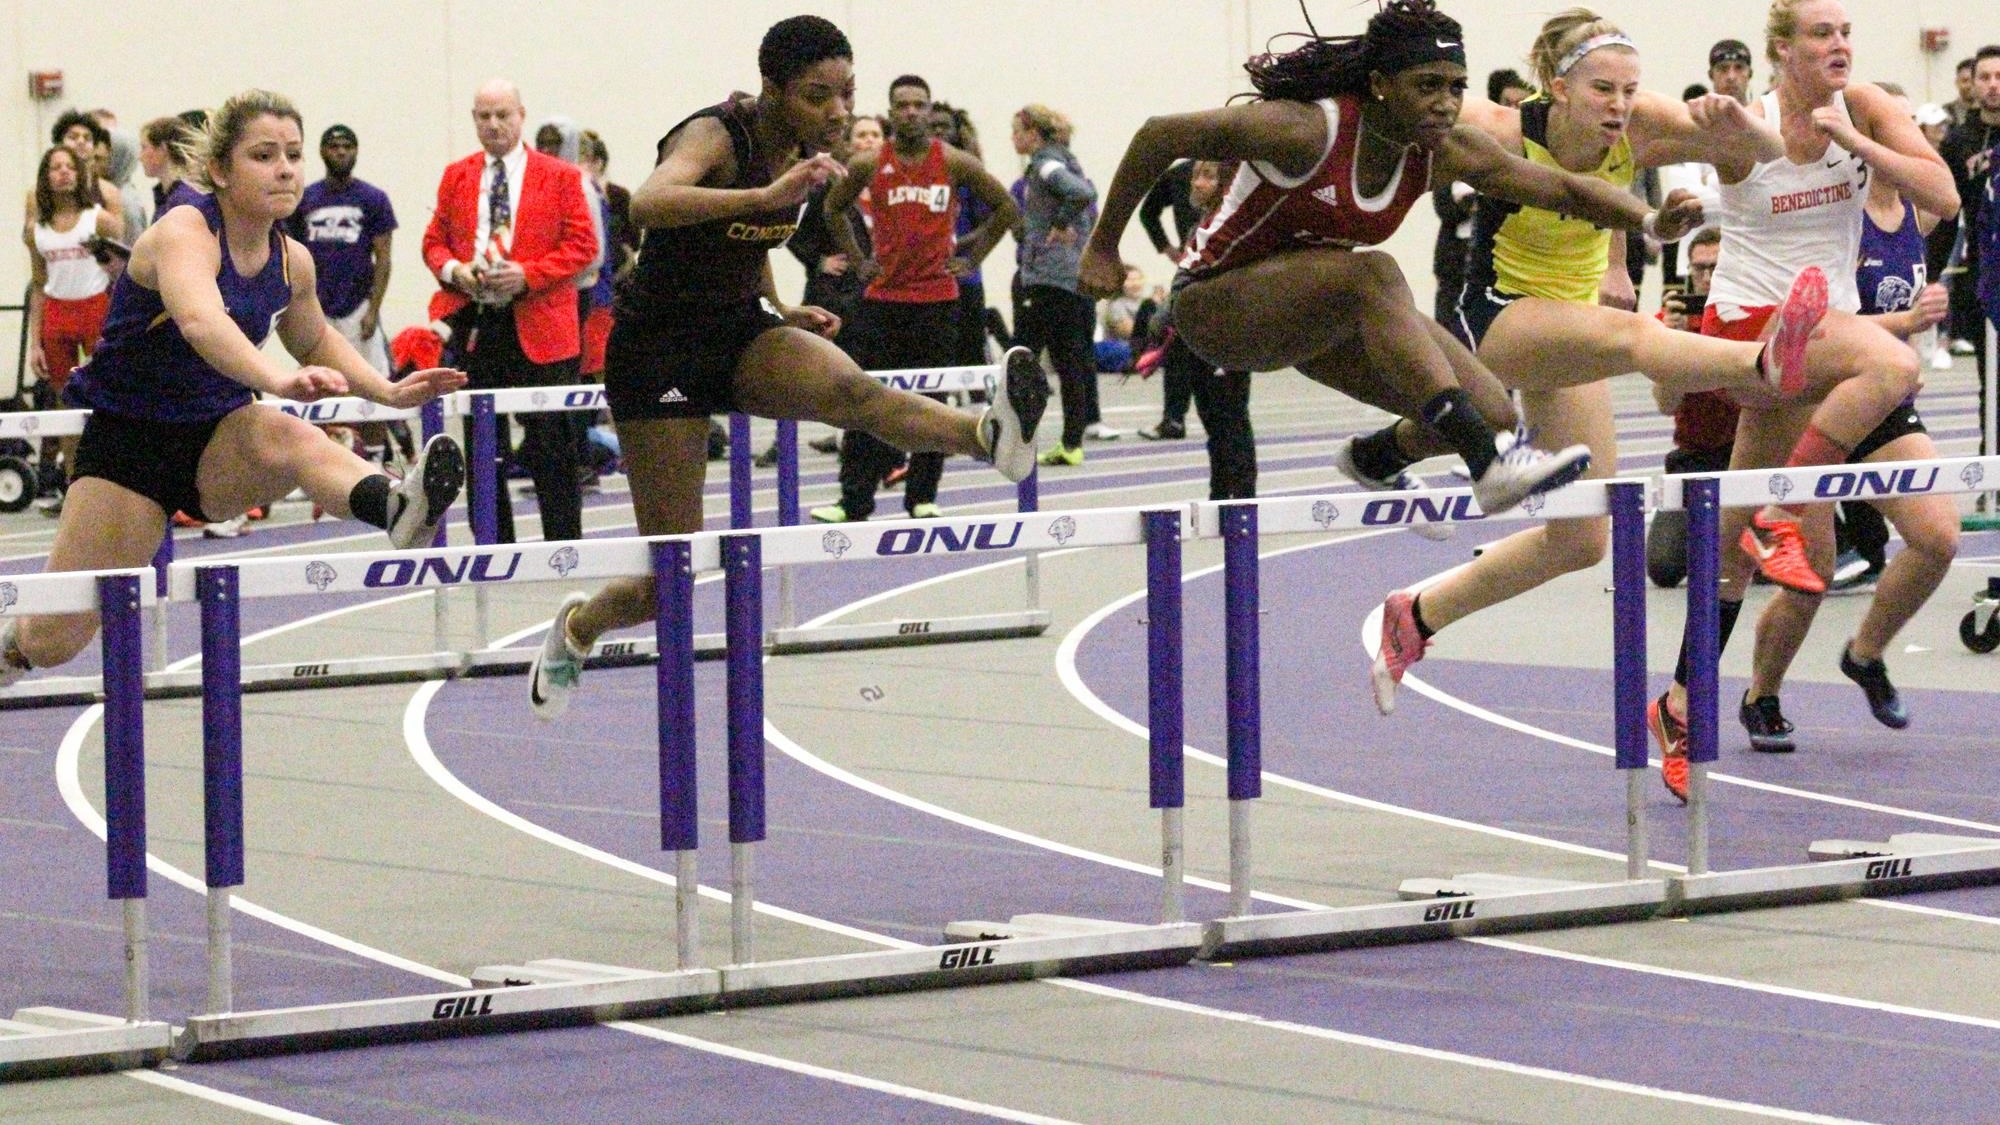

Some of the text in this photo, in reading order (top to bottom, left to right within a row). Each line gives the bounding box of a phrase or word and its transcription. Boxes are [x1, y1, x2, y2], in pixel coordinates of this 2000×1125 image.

[888, 185, 932, 206] LEWIS
[934, 190, 946, 208] 4
[1771, 181, 1852, 214] BENEDICTINE
[876, 372, 945, 390] NU
[281, 403, 341, 420] NU
[1814, 467, 1940, 498] ONU
[876, 522, 1024, 556] ONU
[363, 552, 523, 588] ONU
[898, 621, 930, 635] GILL
[602, 642, 635, 655] GILL
[293, 664, 330, 677] GILL
[1865, 858, 1914, 880] GILL
[1423, 900, 1476, 922] GILL
[940, 946, 997, 969] GILL
[433, 994, 494, 1019] GILL
